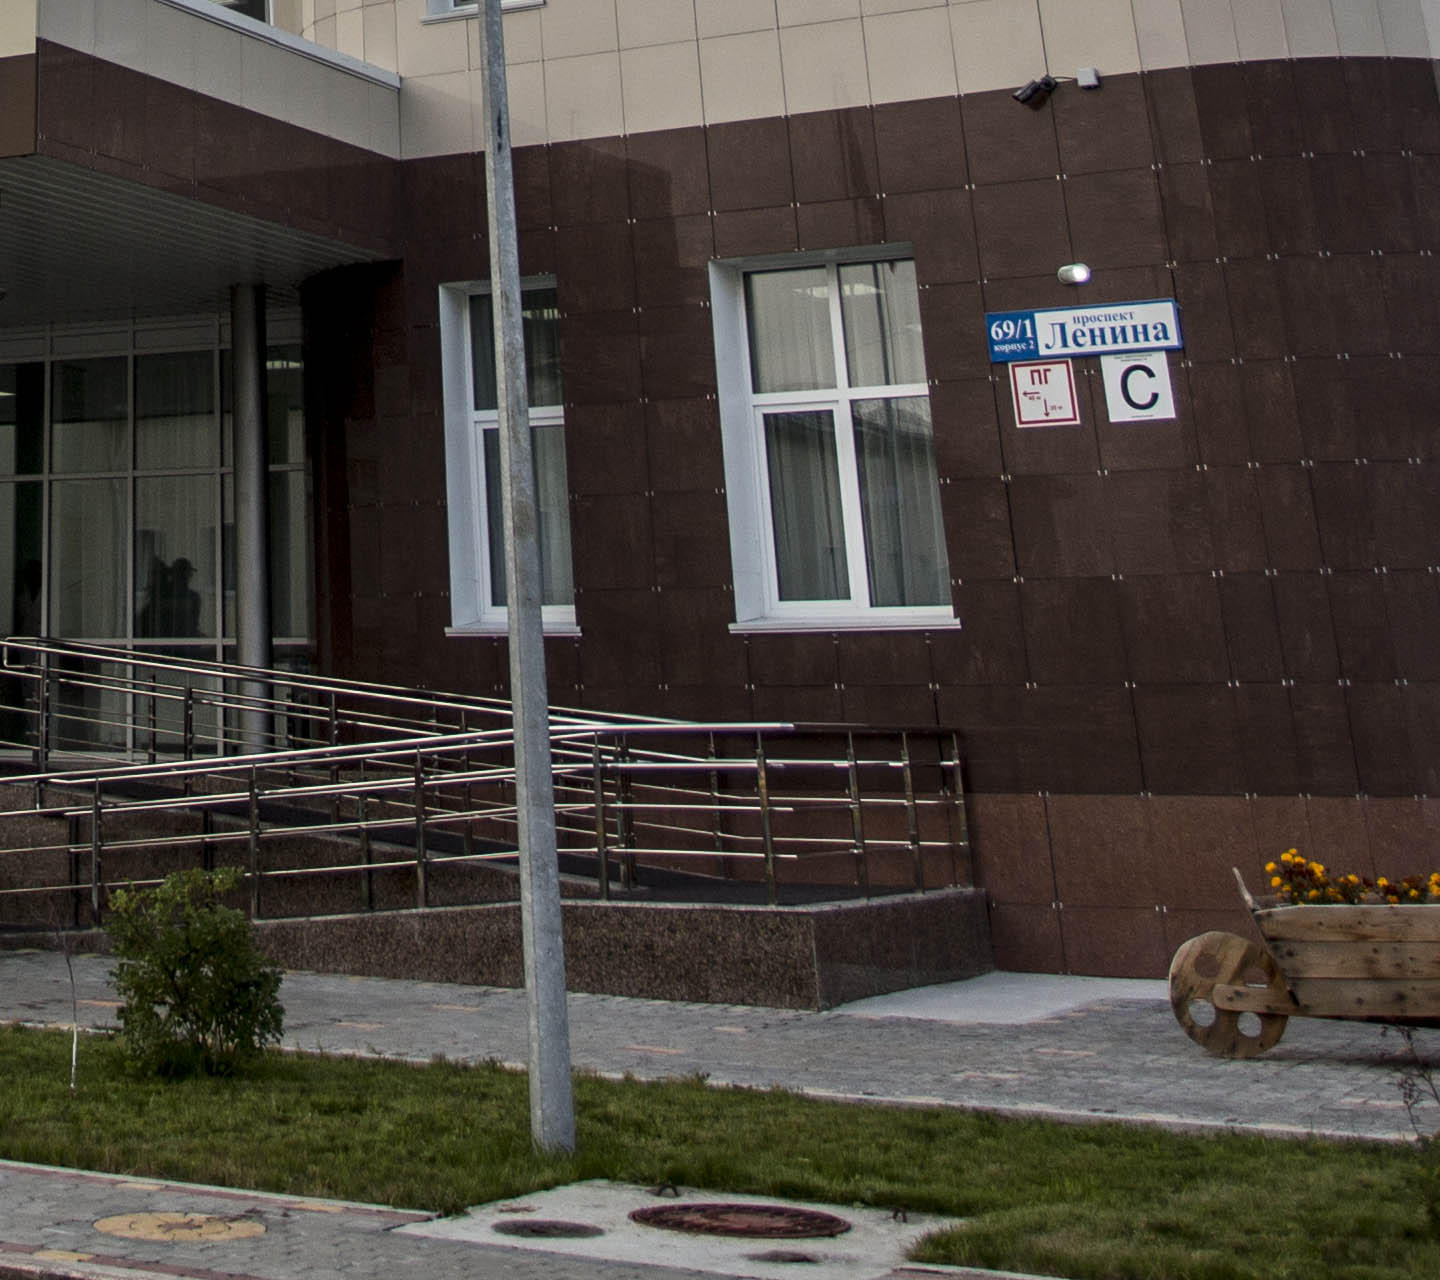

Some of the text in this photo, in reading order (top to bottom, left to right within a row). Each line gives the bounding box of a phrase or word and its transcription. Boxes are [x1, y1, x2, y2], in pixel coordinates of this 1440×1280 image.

[1072, 310, 1136, 327] проспект
[991, 319, 1034, 341] 69/1
[1044, 319, 1170, 350] Ленина
[993, 342, 1027, 353] корпус
[1030, 368, 1051, 385] ПГ
